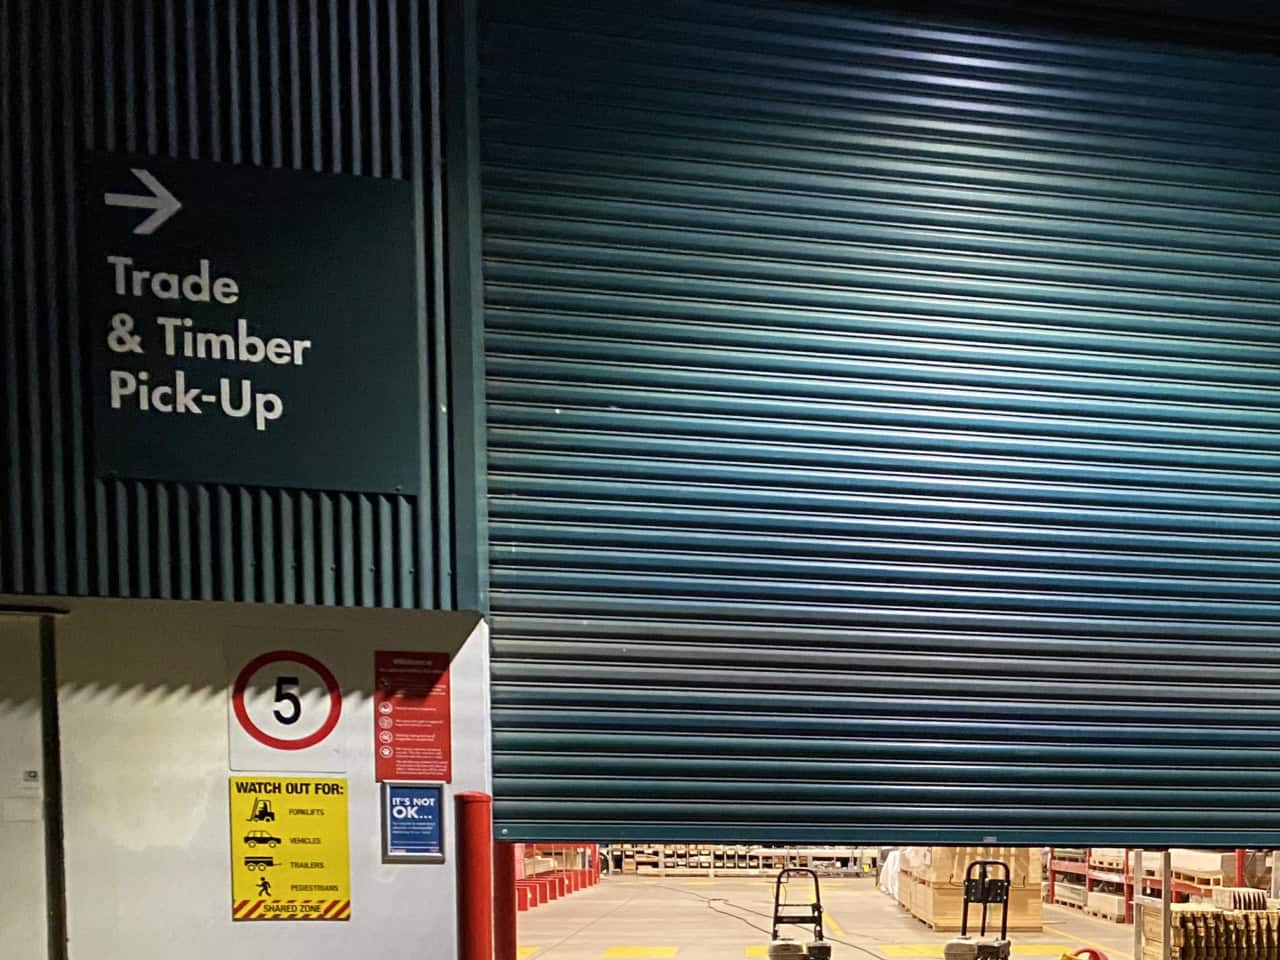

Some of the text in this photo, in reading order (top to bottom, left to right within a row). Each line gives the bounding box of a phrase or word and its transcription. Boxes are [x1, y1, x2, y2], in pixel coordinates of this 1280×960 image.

[107, 255, 239, 304] Trade
[107, 312, 312, 366] & Timber
[109, 369, 284, 431] Pick-Up
[273, 676, 302, 725] 5
[235, 782, 344, 795] WATCH OUT FOR:
[392, 797, 436, 807] IT'S NOT
[288, 808, 325, 816] FORKLIFTS
[290, 861, 325, 869] TRAILERS
[263, 904, 321, 913] SHARED ZONE
